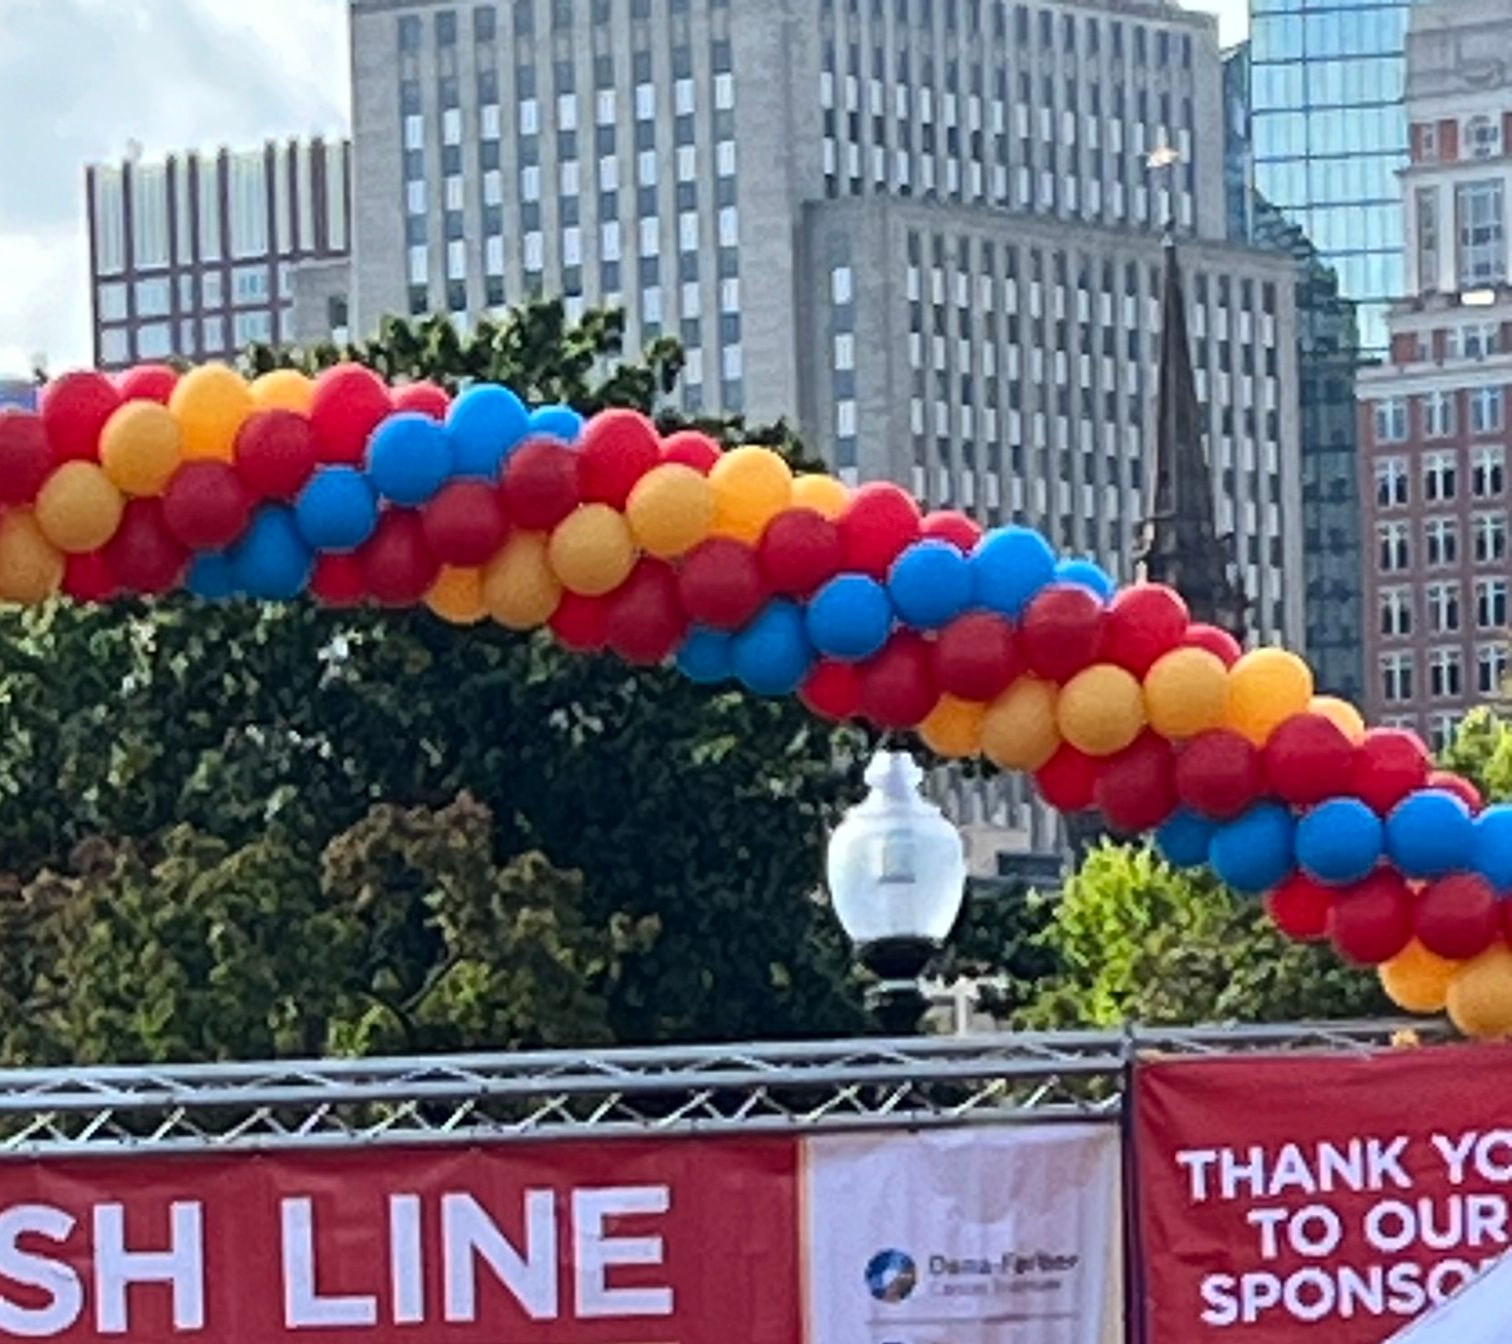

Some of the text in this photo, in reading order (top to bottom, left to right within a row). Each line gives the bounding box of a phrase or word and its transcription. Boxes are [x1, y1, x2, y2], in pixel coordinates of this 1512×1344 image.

[1175, 1128, 1512, 1201] THANK YO
[281, 1184, 675, 1328] LINE
[1247, 1194, 1510, 1260] TO OUR
[1199, 1257, 1496, 1326] SPONSO
